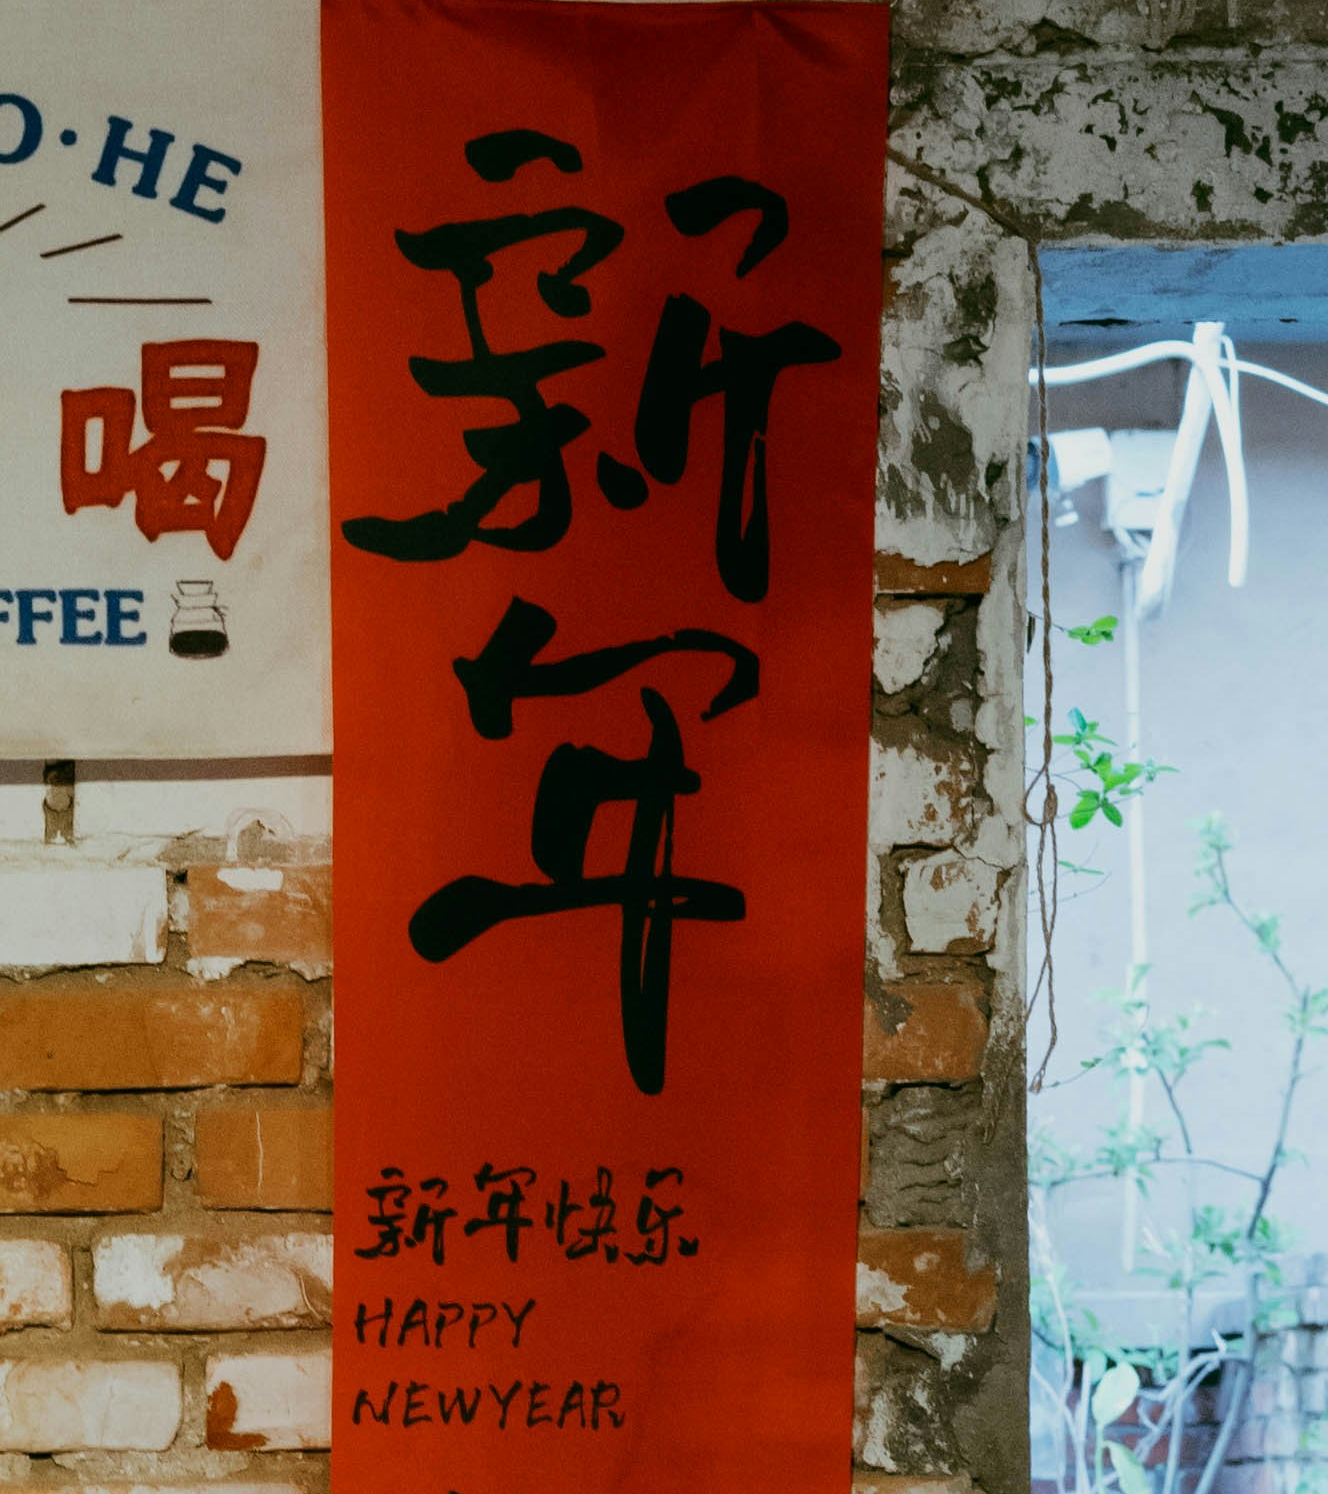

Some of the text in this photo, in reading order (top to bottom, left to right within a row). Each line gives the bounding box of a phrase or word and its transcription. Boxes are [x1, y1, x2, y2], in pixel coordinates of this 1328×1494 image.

[341, 126, 843, 1097] 新年
[352, 1167, 701, 1266] 新年快乐
[356, 1297, 538, 1351] HAPPY
